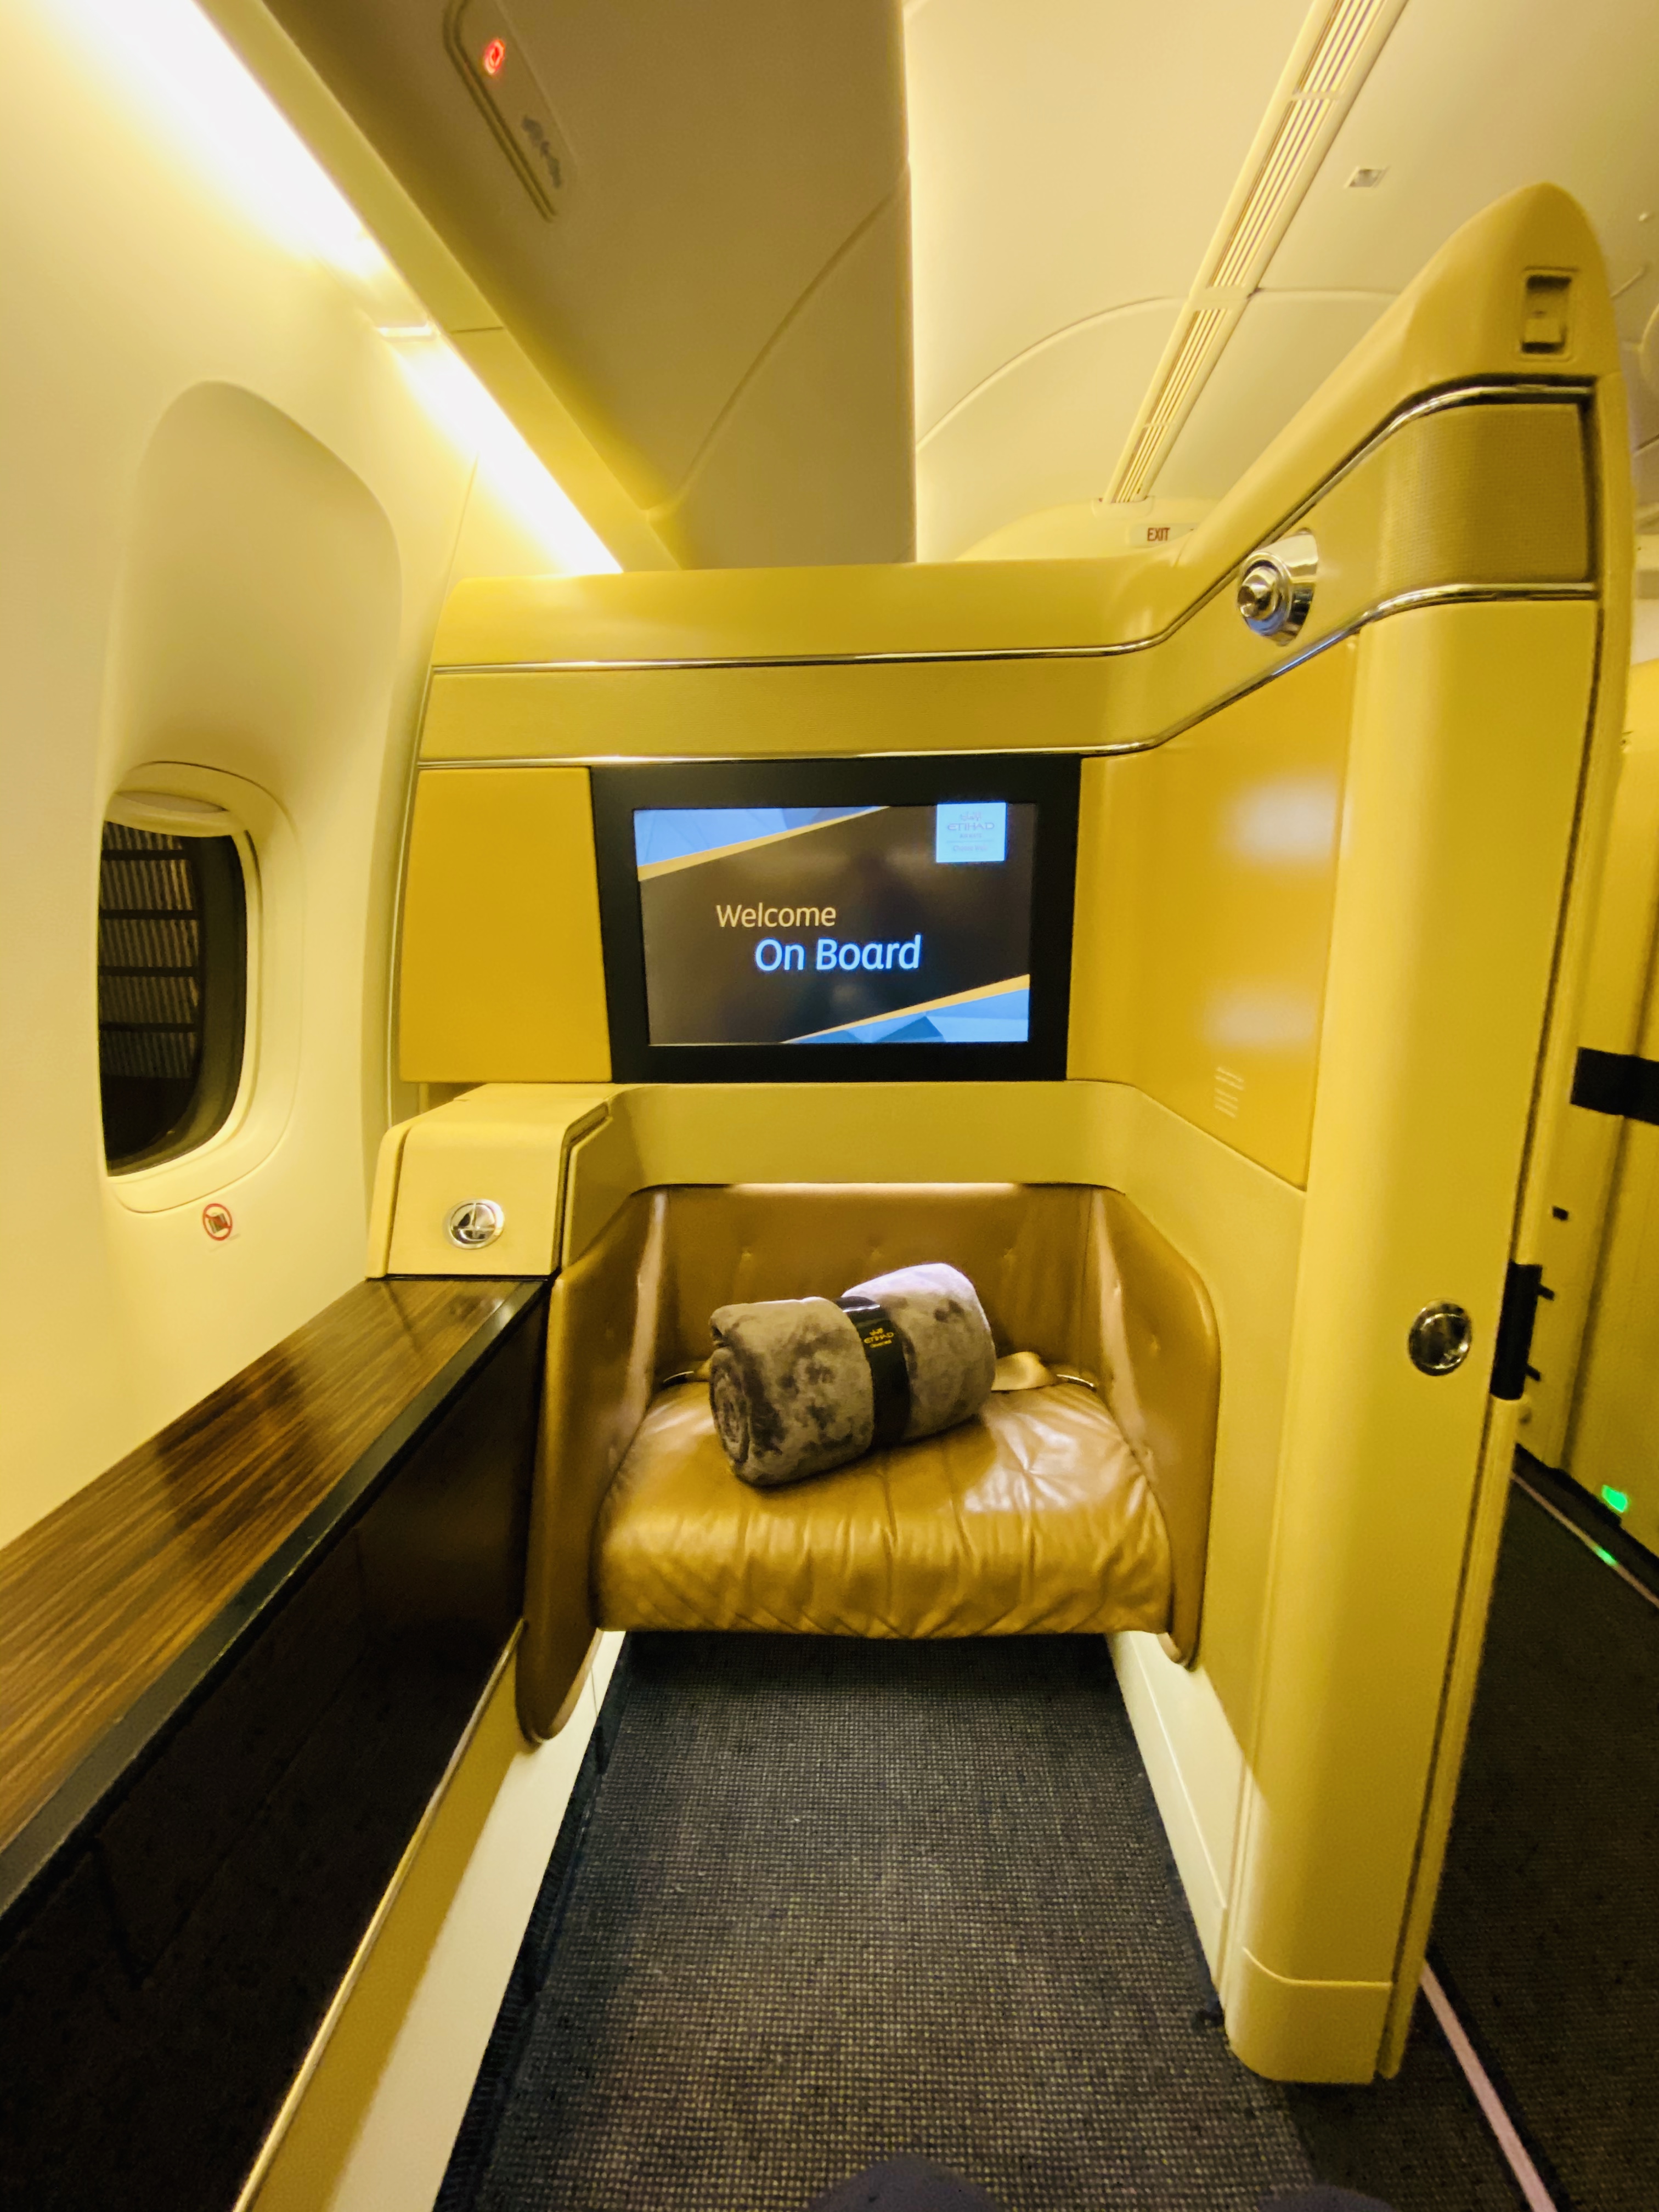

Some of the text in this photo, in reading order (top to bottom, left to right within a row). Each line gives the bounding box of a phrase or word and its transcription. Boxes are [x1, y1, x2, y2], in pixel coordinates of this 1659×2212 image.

[1147, 527, 1170, 541] EXIT
[947, 822, 995, 831] ETIHAD
[716, 902, 837, 928] Welcome
[755, 934, 922, 972] On Board
